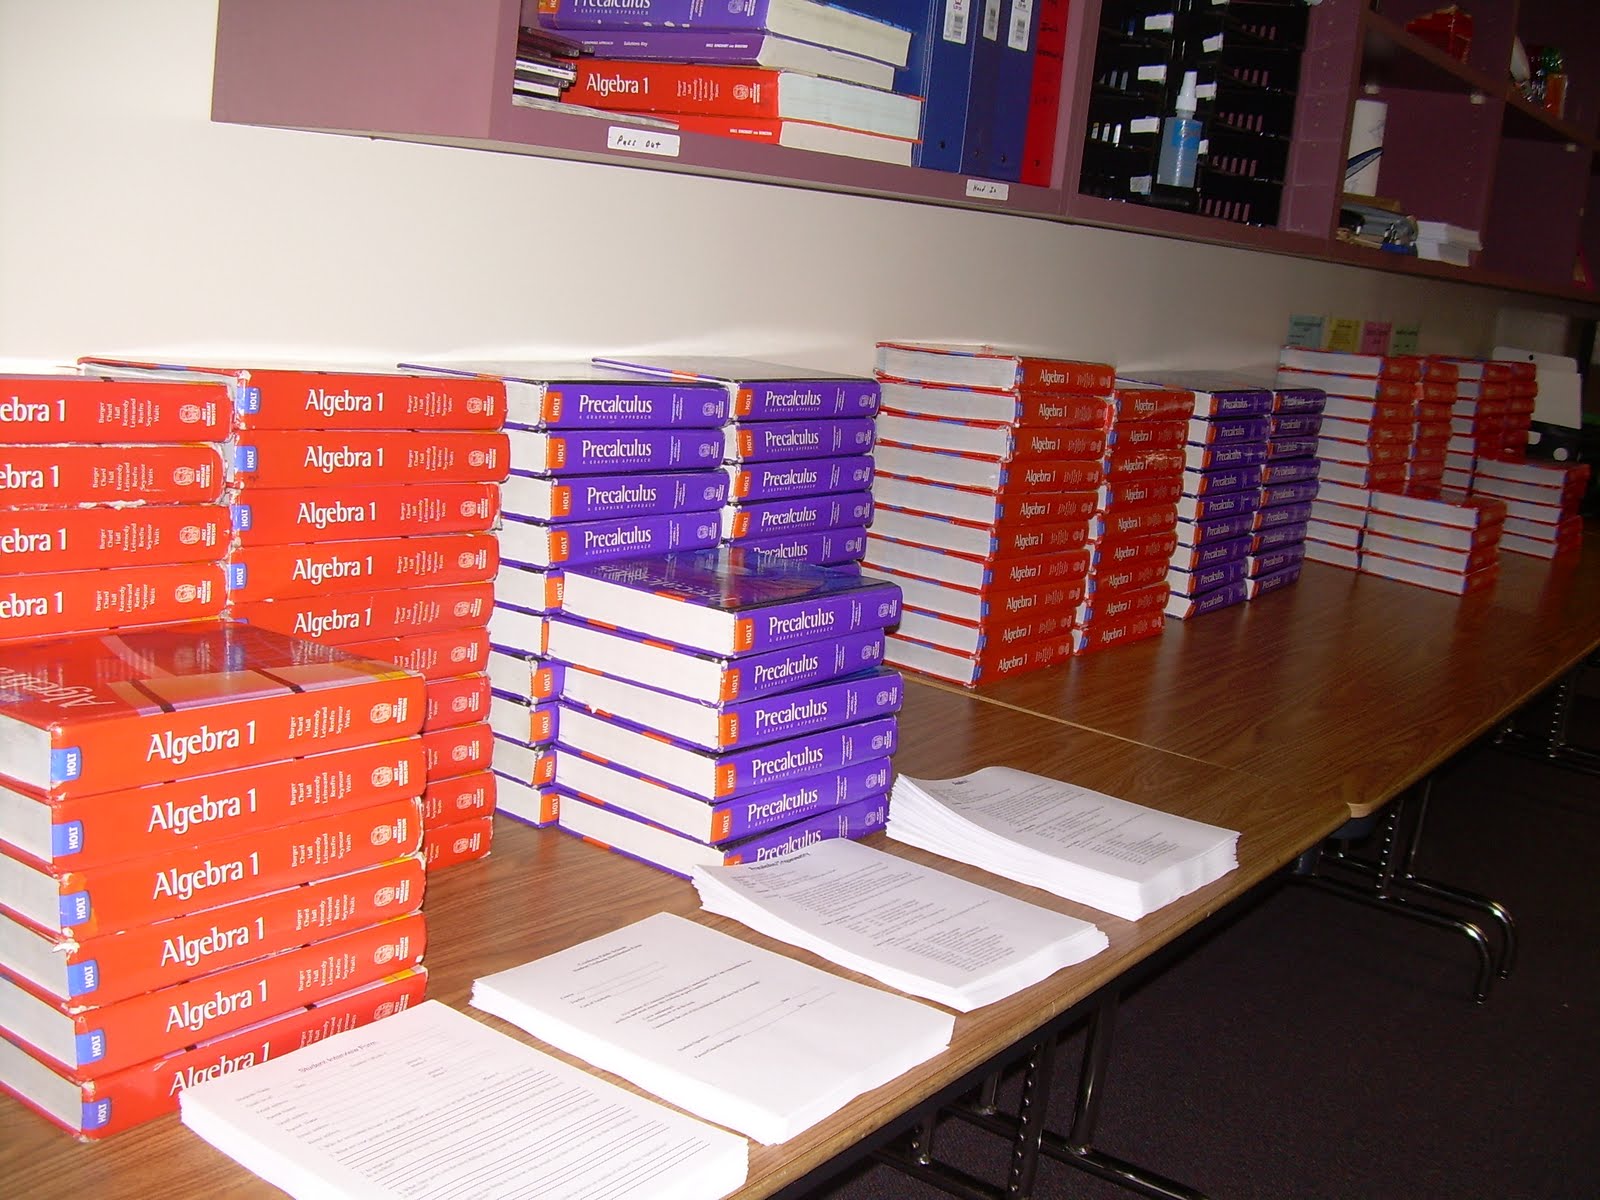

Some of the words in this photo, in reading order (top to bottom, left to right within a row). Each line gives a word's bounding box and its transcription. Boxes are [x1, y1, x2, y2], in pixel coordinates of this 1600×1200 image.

[586, 73, 640, 97] Algebra
[643, 77, 649, 94] 1
[1040, 370, 1064, 385] Algebra
[305, 389, 372, 417] Algebra
[377, 392, 384, 412] 1
[552, 397, 560, 416] HOLT
[579, 394, 652, 416] Precalculus
[765, 390, 821, 406] Precalculus
[56, 400, 66, 422] 1
[1039, 404, 1063, 418] Algebra
[765, 429, 819, 448] Precalculus
[1129, 431, 1148, 443] Algebra
[1221, 426, 1244, 436] Precalculus
[582, 441, 652, 458] Precalculus
[1031, 436, 1056, 452] Algebra
[304, 445, 371, 474] Algebra
[377, 448, 383, 467] 1
[50, 465, 59, 488] 1
[763, 470, 817, 488] Precalculus
[1025, 470, 1051, 485] Algebra
[587, 486, 657, 505] Precalculus
[297, 502, 366, 529] Algebra
[369, 502, 376, 521] 1
[761, 508, 817, 526] Precalculus
[1020, 502, 1046, 518] Algebra
[0, 528, 51, 553] ebra
[58, 528, 67, 550] 1
[585, 528, 651, 548] Precalculus
[754, 541, 808, 558] ecalculus
[1014, 534, 1039, 550] Algebra
[293, 557, 361, 584] Algebra
[366, 556, 373, 575] 1
[1010, 566, 1036, 581] Algebra
[54, 591, 64, 614] 1
[1006, 596, 1032, 612] Algebra
[293, 609, 360, 638] Algebra
[365, 608, 372, 626] 1
[769, 609, 835, 635] Precalculus
[1002, 627, 1026, 644] Algebra
[754, 654, 818, 684] Precalculus
[998, 658, 1022, 674] Algebra
[756, 699, 827, 729] Precalculus
[147, 723, 240, 764] Algebra
[247, 721, 257, 745] 1
[66, 752, 76, 777] HOLT
[752, 746, 823, 777] Precalculus
[148, 790, 241, 834] Algebra
[248, 788, 258, 813] 1
[748, 787, 818, 821] Precalculus
[68, 825, 79, 851] HOLT
[756, 828, 822, 862] Precalculus
[153, 860, 244, 900] Algebra
[250, 852, 259, 875] 1
[76, 897, 86, 920] HOLT
[161, 926, 250, 966] Algebra
[255, 916, 265, 940] 1
[84, 965, 95, 988] HOLT
[166, 988, 253, 1032] Algebra
[258, 979, 268, 1002] 1
[91, 1034, 102, 1058] HOLT
[169, 1052, 255, 1096] Algebra
[262, 1042, 270, 1062] 1
[98, 1102, 108, 1124] HOLT
